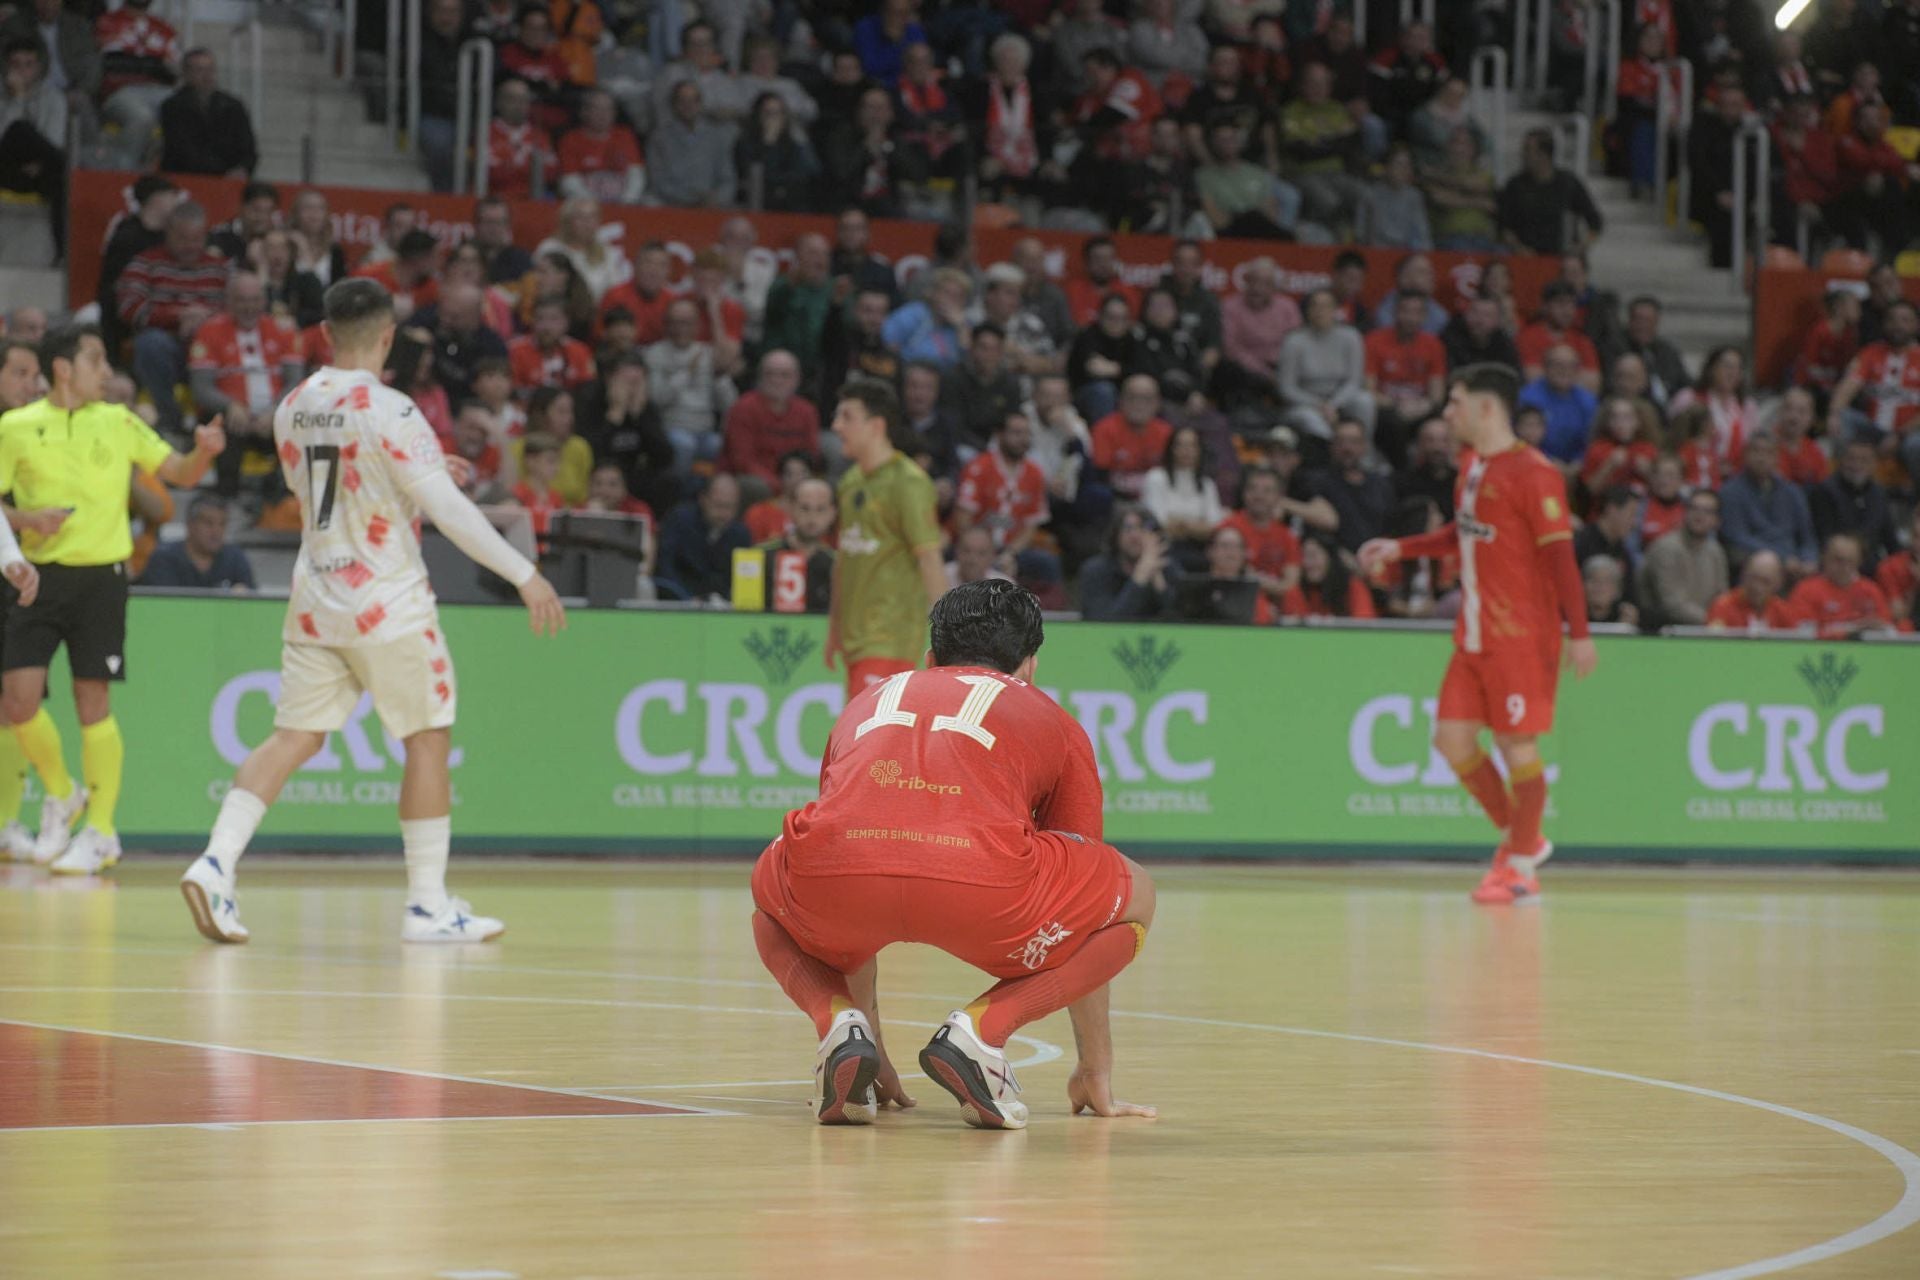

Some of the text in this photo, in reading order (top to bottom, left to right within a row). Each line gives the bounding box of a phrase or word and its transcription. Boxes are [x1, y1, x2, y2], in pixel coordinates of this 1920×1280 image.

[292, 411, 344, 430] Rivera
[305, 445, 340, 530] 17
[778, 555, 806, 602] 5
[854, 670, 1008, 751] 11
[1506, 693, 1526, 726] 9
[1036, 687, 1216, 784] RC
[1687, 700, 1889, 794] CRC
[898, 776, 962, 795] ribera
[846, 829, 888, 839] SEMPER
[890, 830, 925, 842] SIMUL
[936, 834, 971, 849] ASTRA
